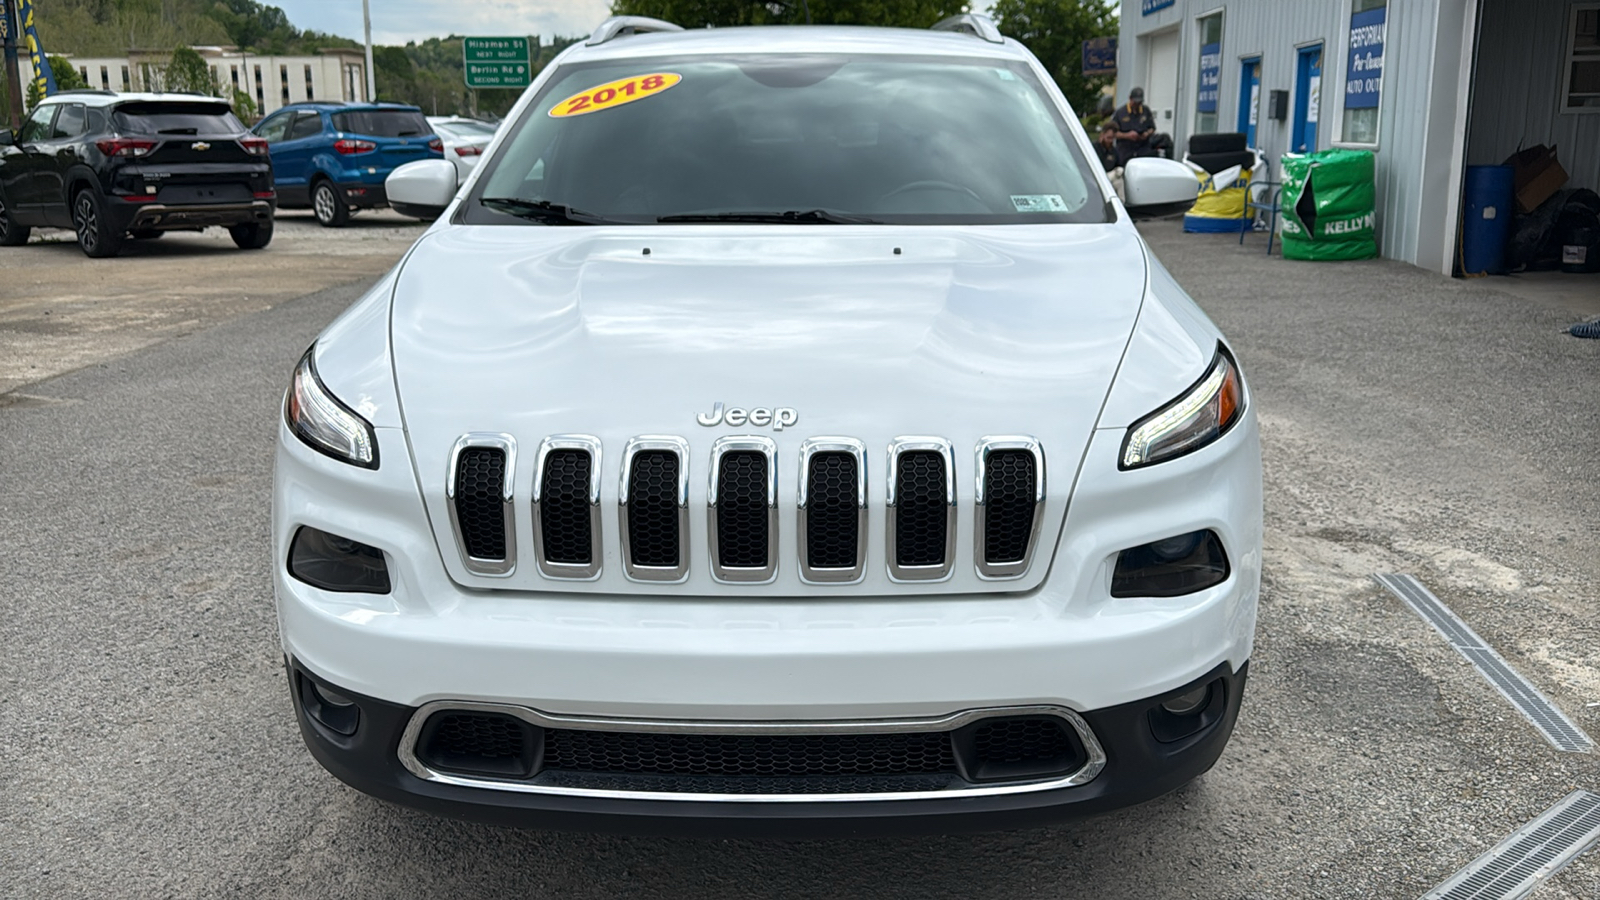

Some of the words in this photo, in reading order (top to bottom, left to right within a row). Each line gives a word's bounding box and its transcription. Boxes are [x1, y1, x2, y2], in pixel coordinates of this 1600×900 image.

[513, 40, 523, 48] St
[471, 65, 498, 74] Berlin
[502, 65, 514, 74] Rd
[567, 75, 666, 114] 2018
[1347, 79, 1363, 94] AUTO
[1325, 216, 1363, 235] KELLY
[697, 401, 798, 432] Jeep
